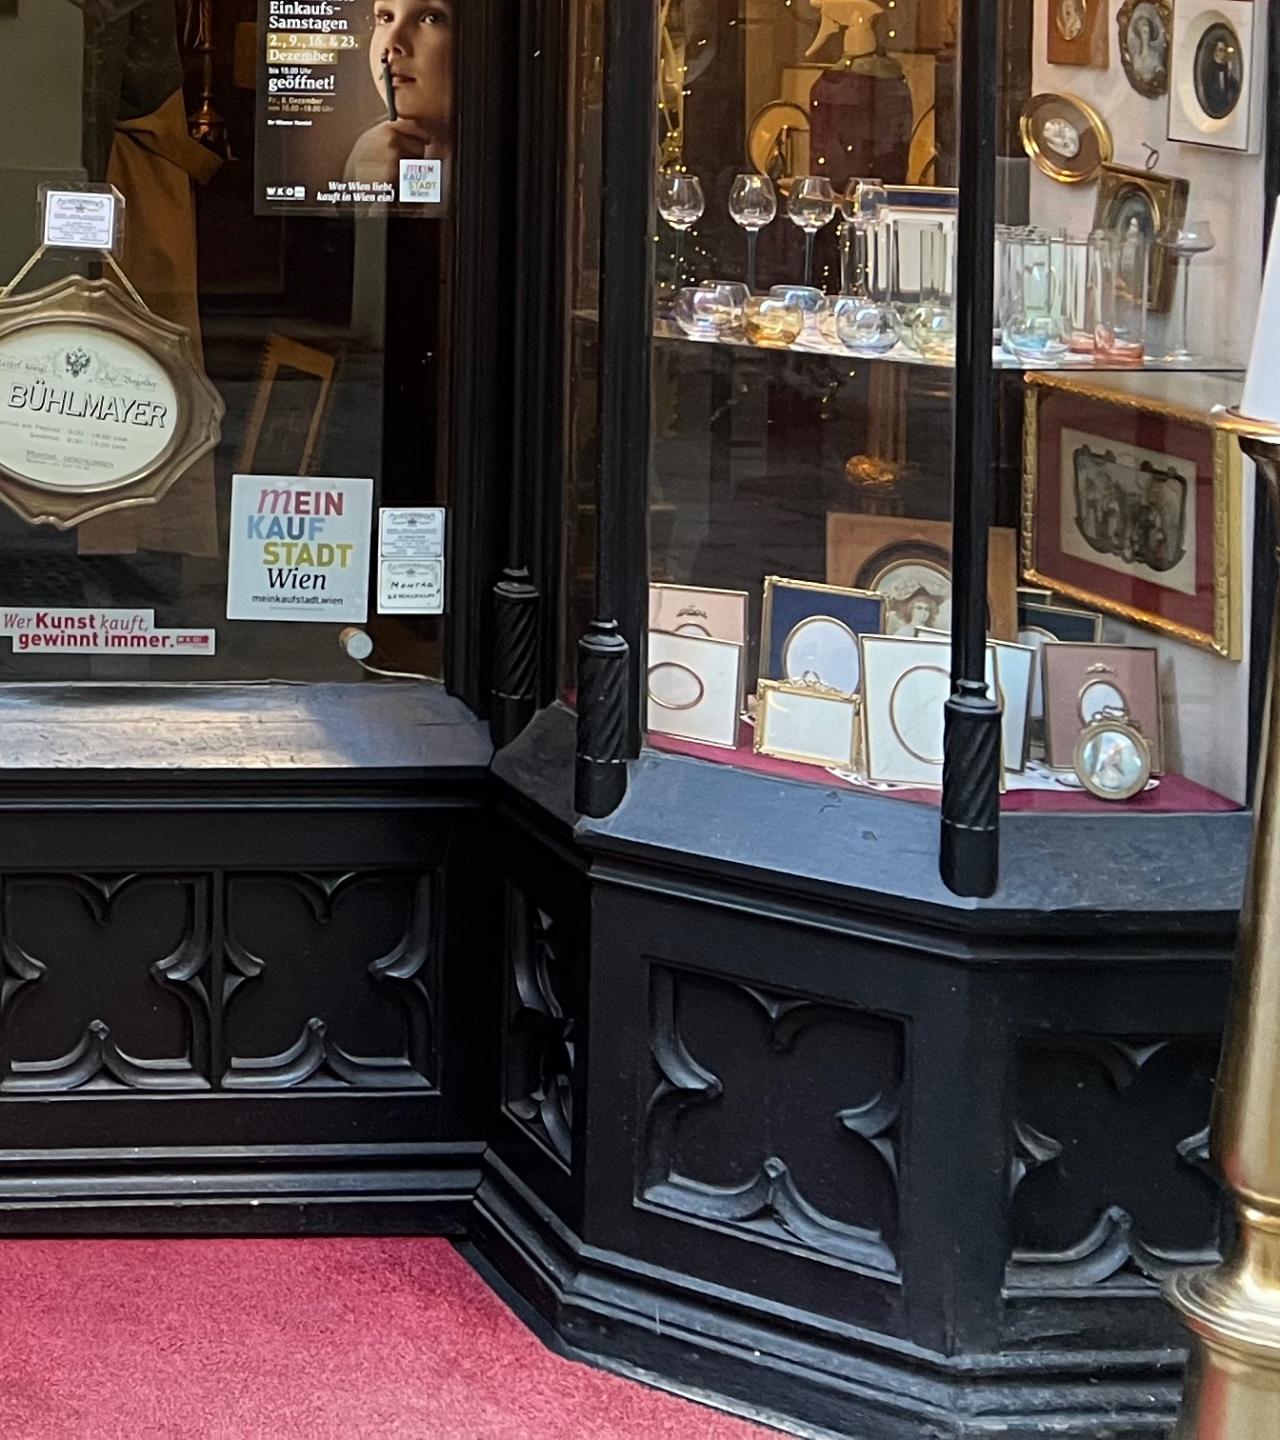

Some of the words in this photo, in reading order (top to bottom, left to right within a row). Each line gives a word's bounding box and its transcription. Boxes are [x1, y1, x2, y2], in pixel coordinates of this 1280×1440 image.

[270, 1, 341, 15] Einkaufs-
[269, 16, 348, 33] Samstagen
[329, 36, 338, 47] &
[341, 36, 359, 48] 23.
[270, 49, 334, 62] Dezember
[268, 75, 334, 92] geöffnet!
[403, 173, 427, 181] KAUF
[328, 181, 347, 191] Wer
[347, 182, 371, 191] Wien
[409, 181, 437, 190] STADT
[317, 191, 341, 204] kauft
[341, 192, 351, 201] in
[353, 192, 375, 201] Wien
[8, 379, 168, 428] BÜHLMAYER
[247, 515, 326, 540] KAUF
[263, 542, 353, 568] STADT
[267, 568, 327, 590] Wien
[252, 594, 344, 606] meinkaufstadt.wien
[3, 613, 31, 629] Wer
[35, 612, 96, 630] Kunst
[99, 613, 149, 634] kauft,
[18, 630, 99, 650] gewinnt
[104, 630, 174, 648] immer.
